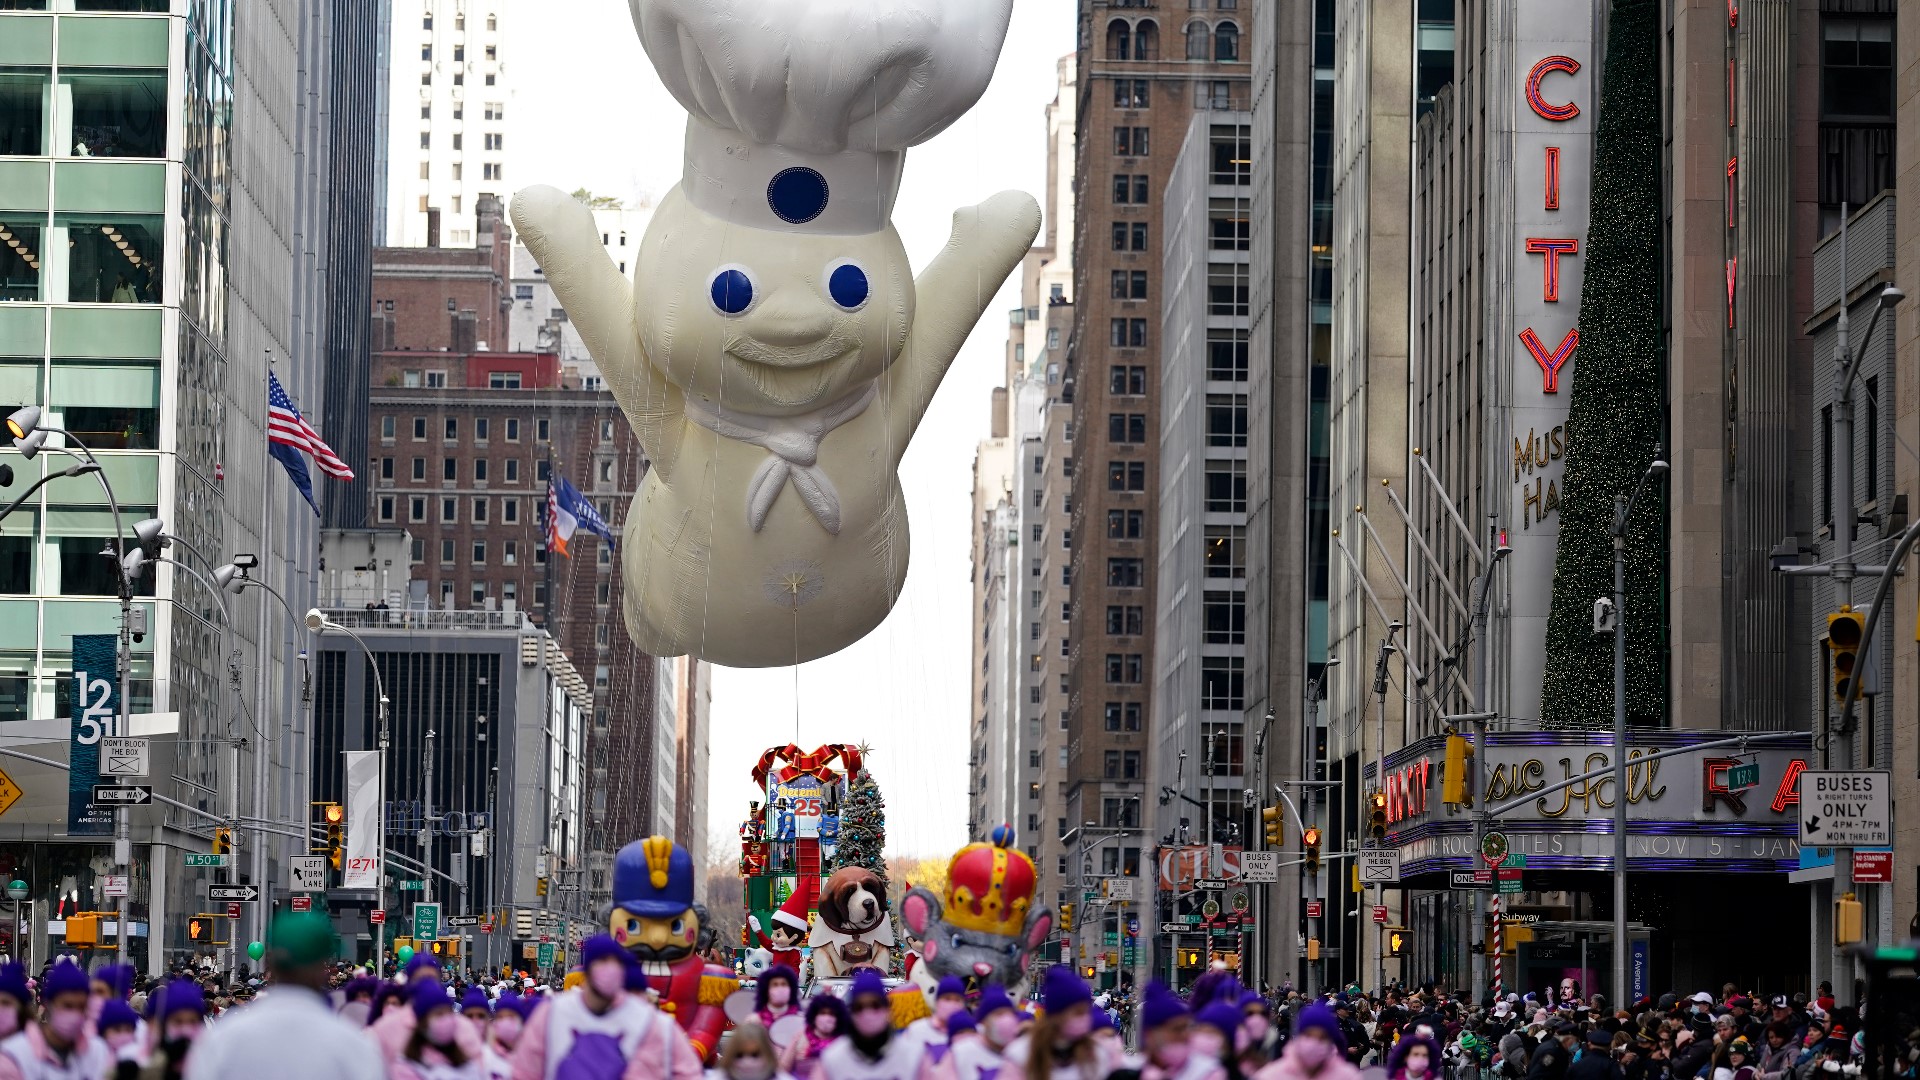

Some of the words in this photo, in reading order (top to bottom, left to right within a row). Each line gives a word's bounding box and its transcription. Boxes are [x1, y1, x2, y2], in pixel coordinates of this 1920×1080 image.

[1518, 54, 1582, 394] CITY
[1514, 419, 1569, 484] MUSI
[1523, 476, 1560, 530] HA
[1817, 778, 1872, 792] BUSES
[794, 799, 822, 816] 25
[1823, 804, 1867, 818] ONLY
[1826, 832, 1846, 840] MON
[1872, 832, 1886, 840] FRI
[1636, 837, 1687, 855] NOV
[1710, 837, 1721, 855] 5
[186, 856, 194, 864] W
[198, 856, 212, 864] 50
[348, 858, 374, 871] 1271
[1082, 840, 1094, 921] WARWK
[1456, 874, 1474, 882] ONE
[1501, 912, 1540, 922] Subway
